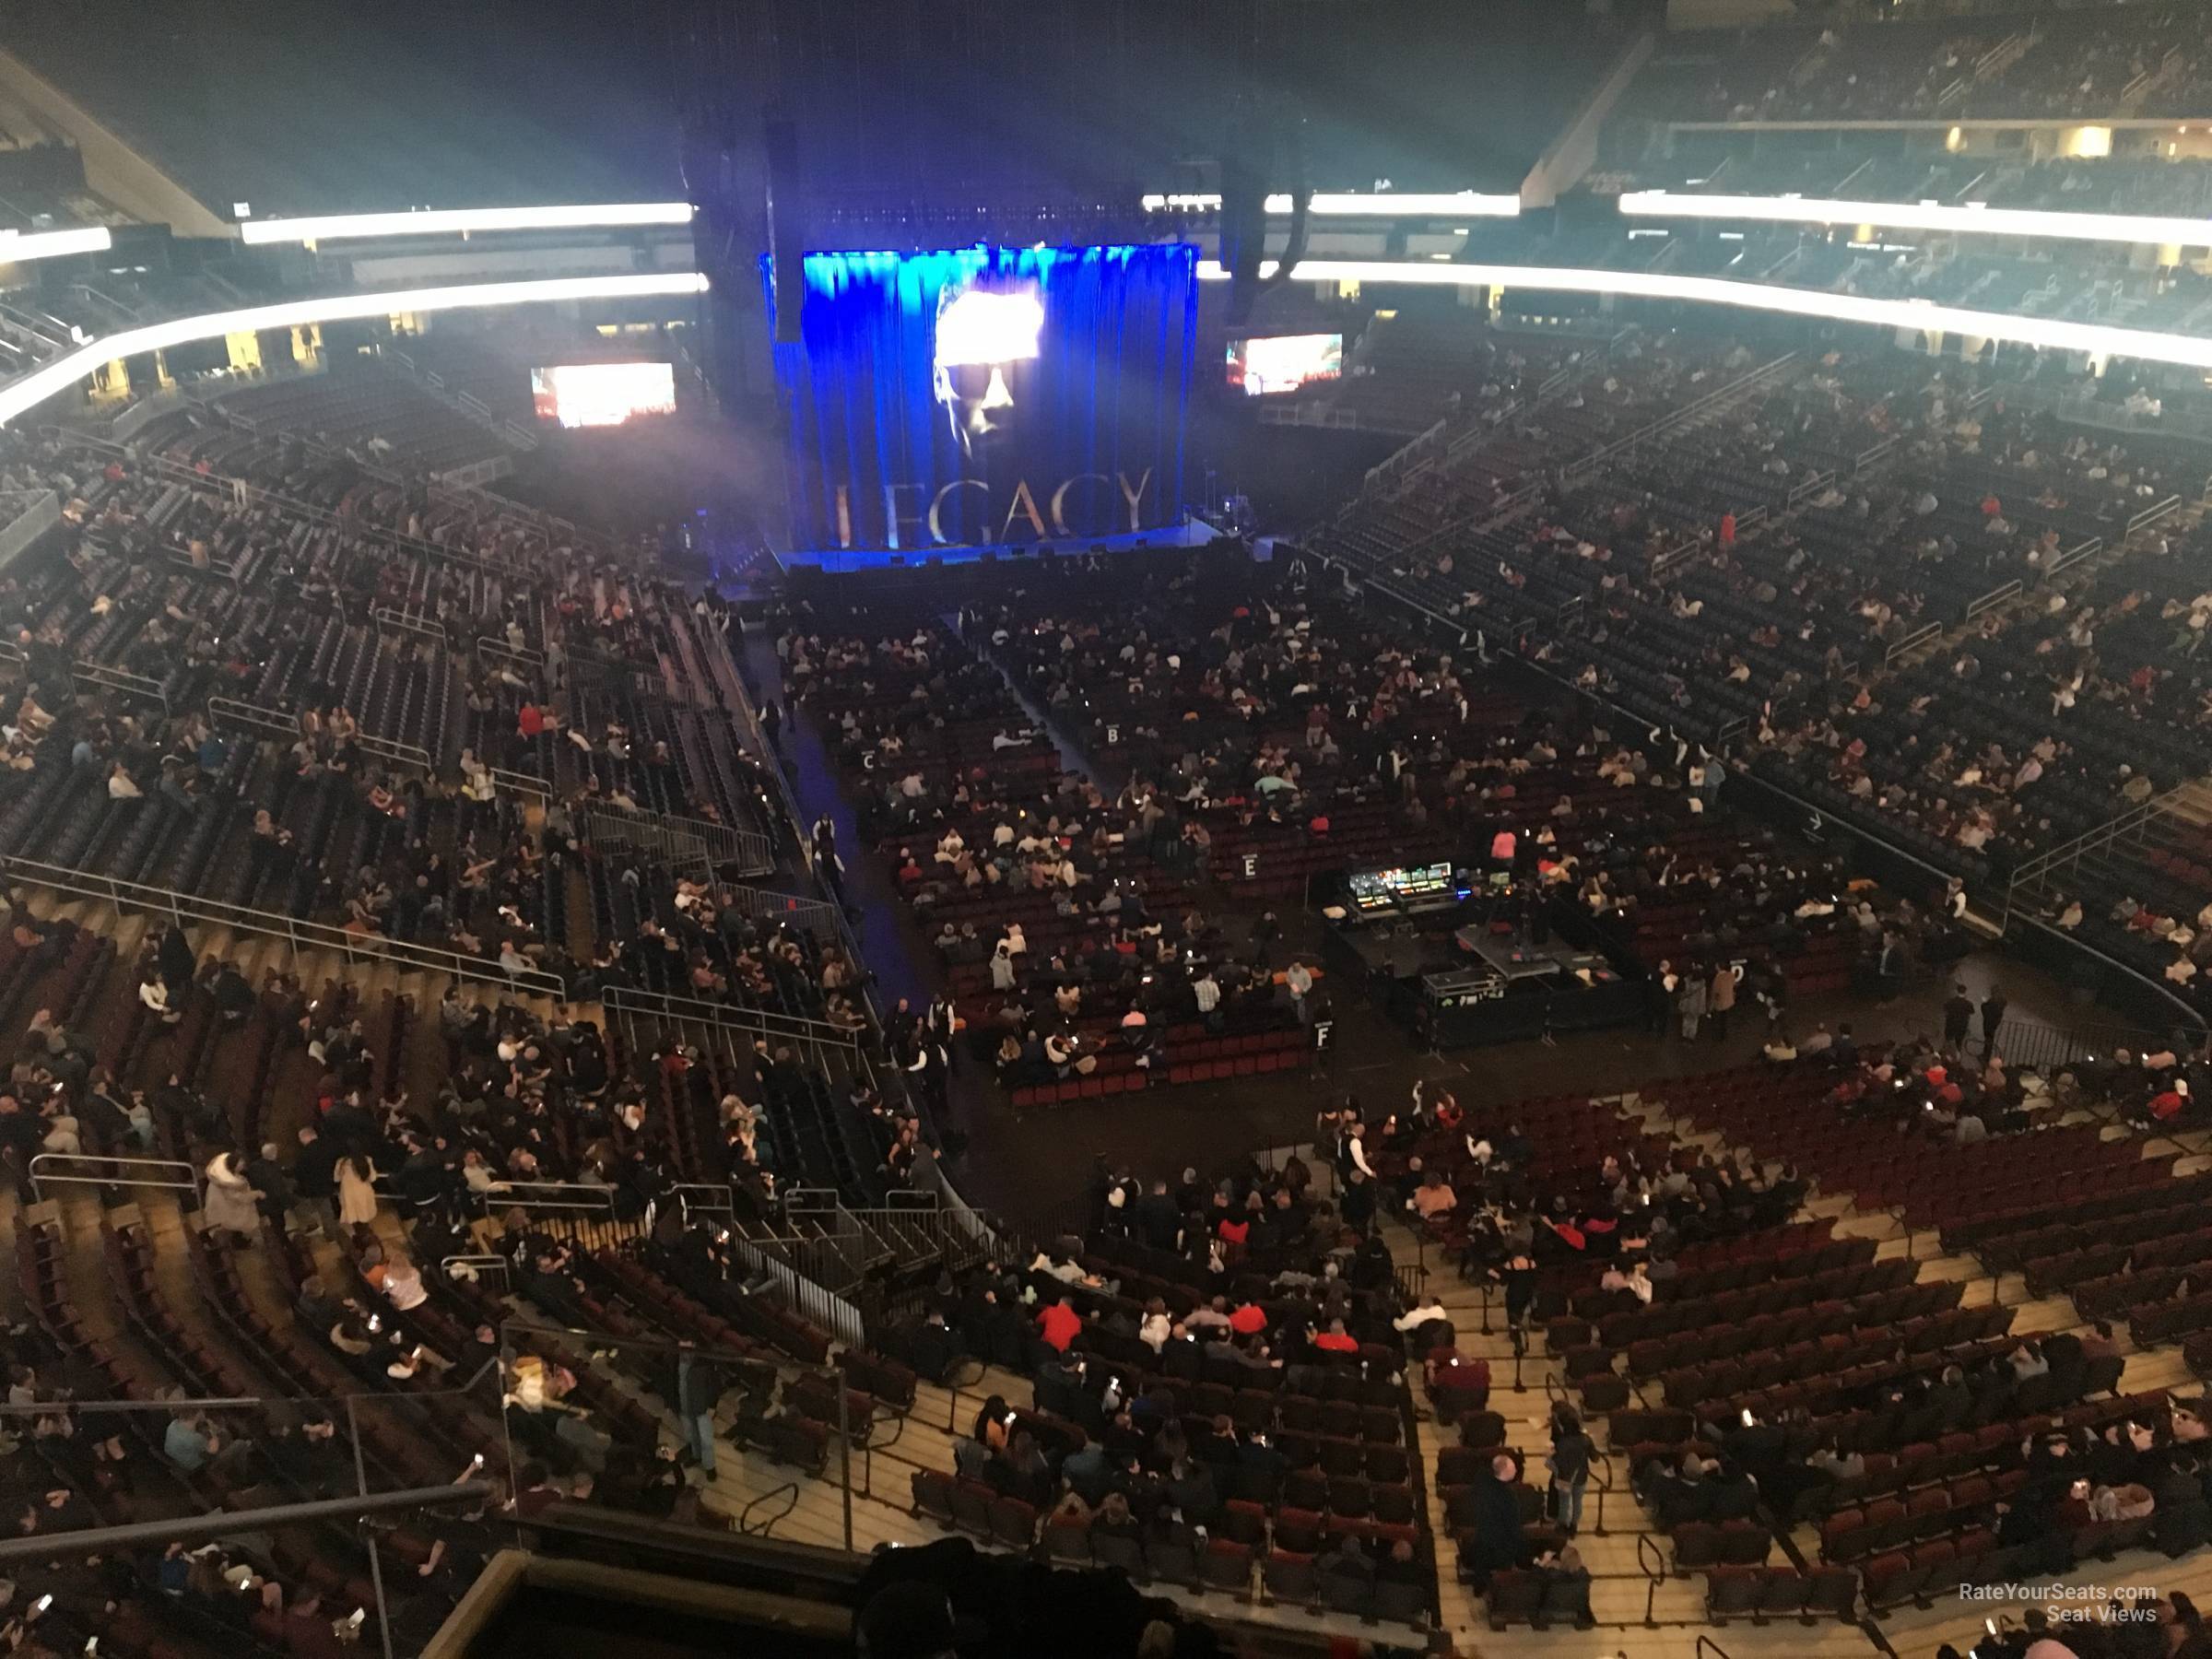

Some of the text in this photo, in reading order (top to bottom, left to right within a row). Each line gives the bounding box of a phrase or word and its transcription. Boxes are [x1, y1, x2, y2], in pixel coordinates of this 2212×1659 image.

[1347, 704, 1357, 718] A
[1108, 729, 1118, 743] B
[864, 755, 874, 769] C
[1245, 859, 1255, 876] E
[1318, 1027, 1329, 1047] F
